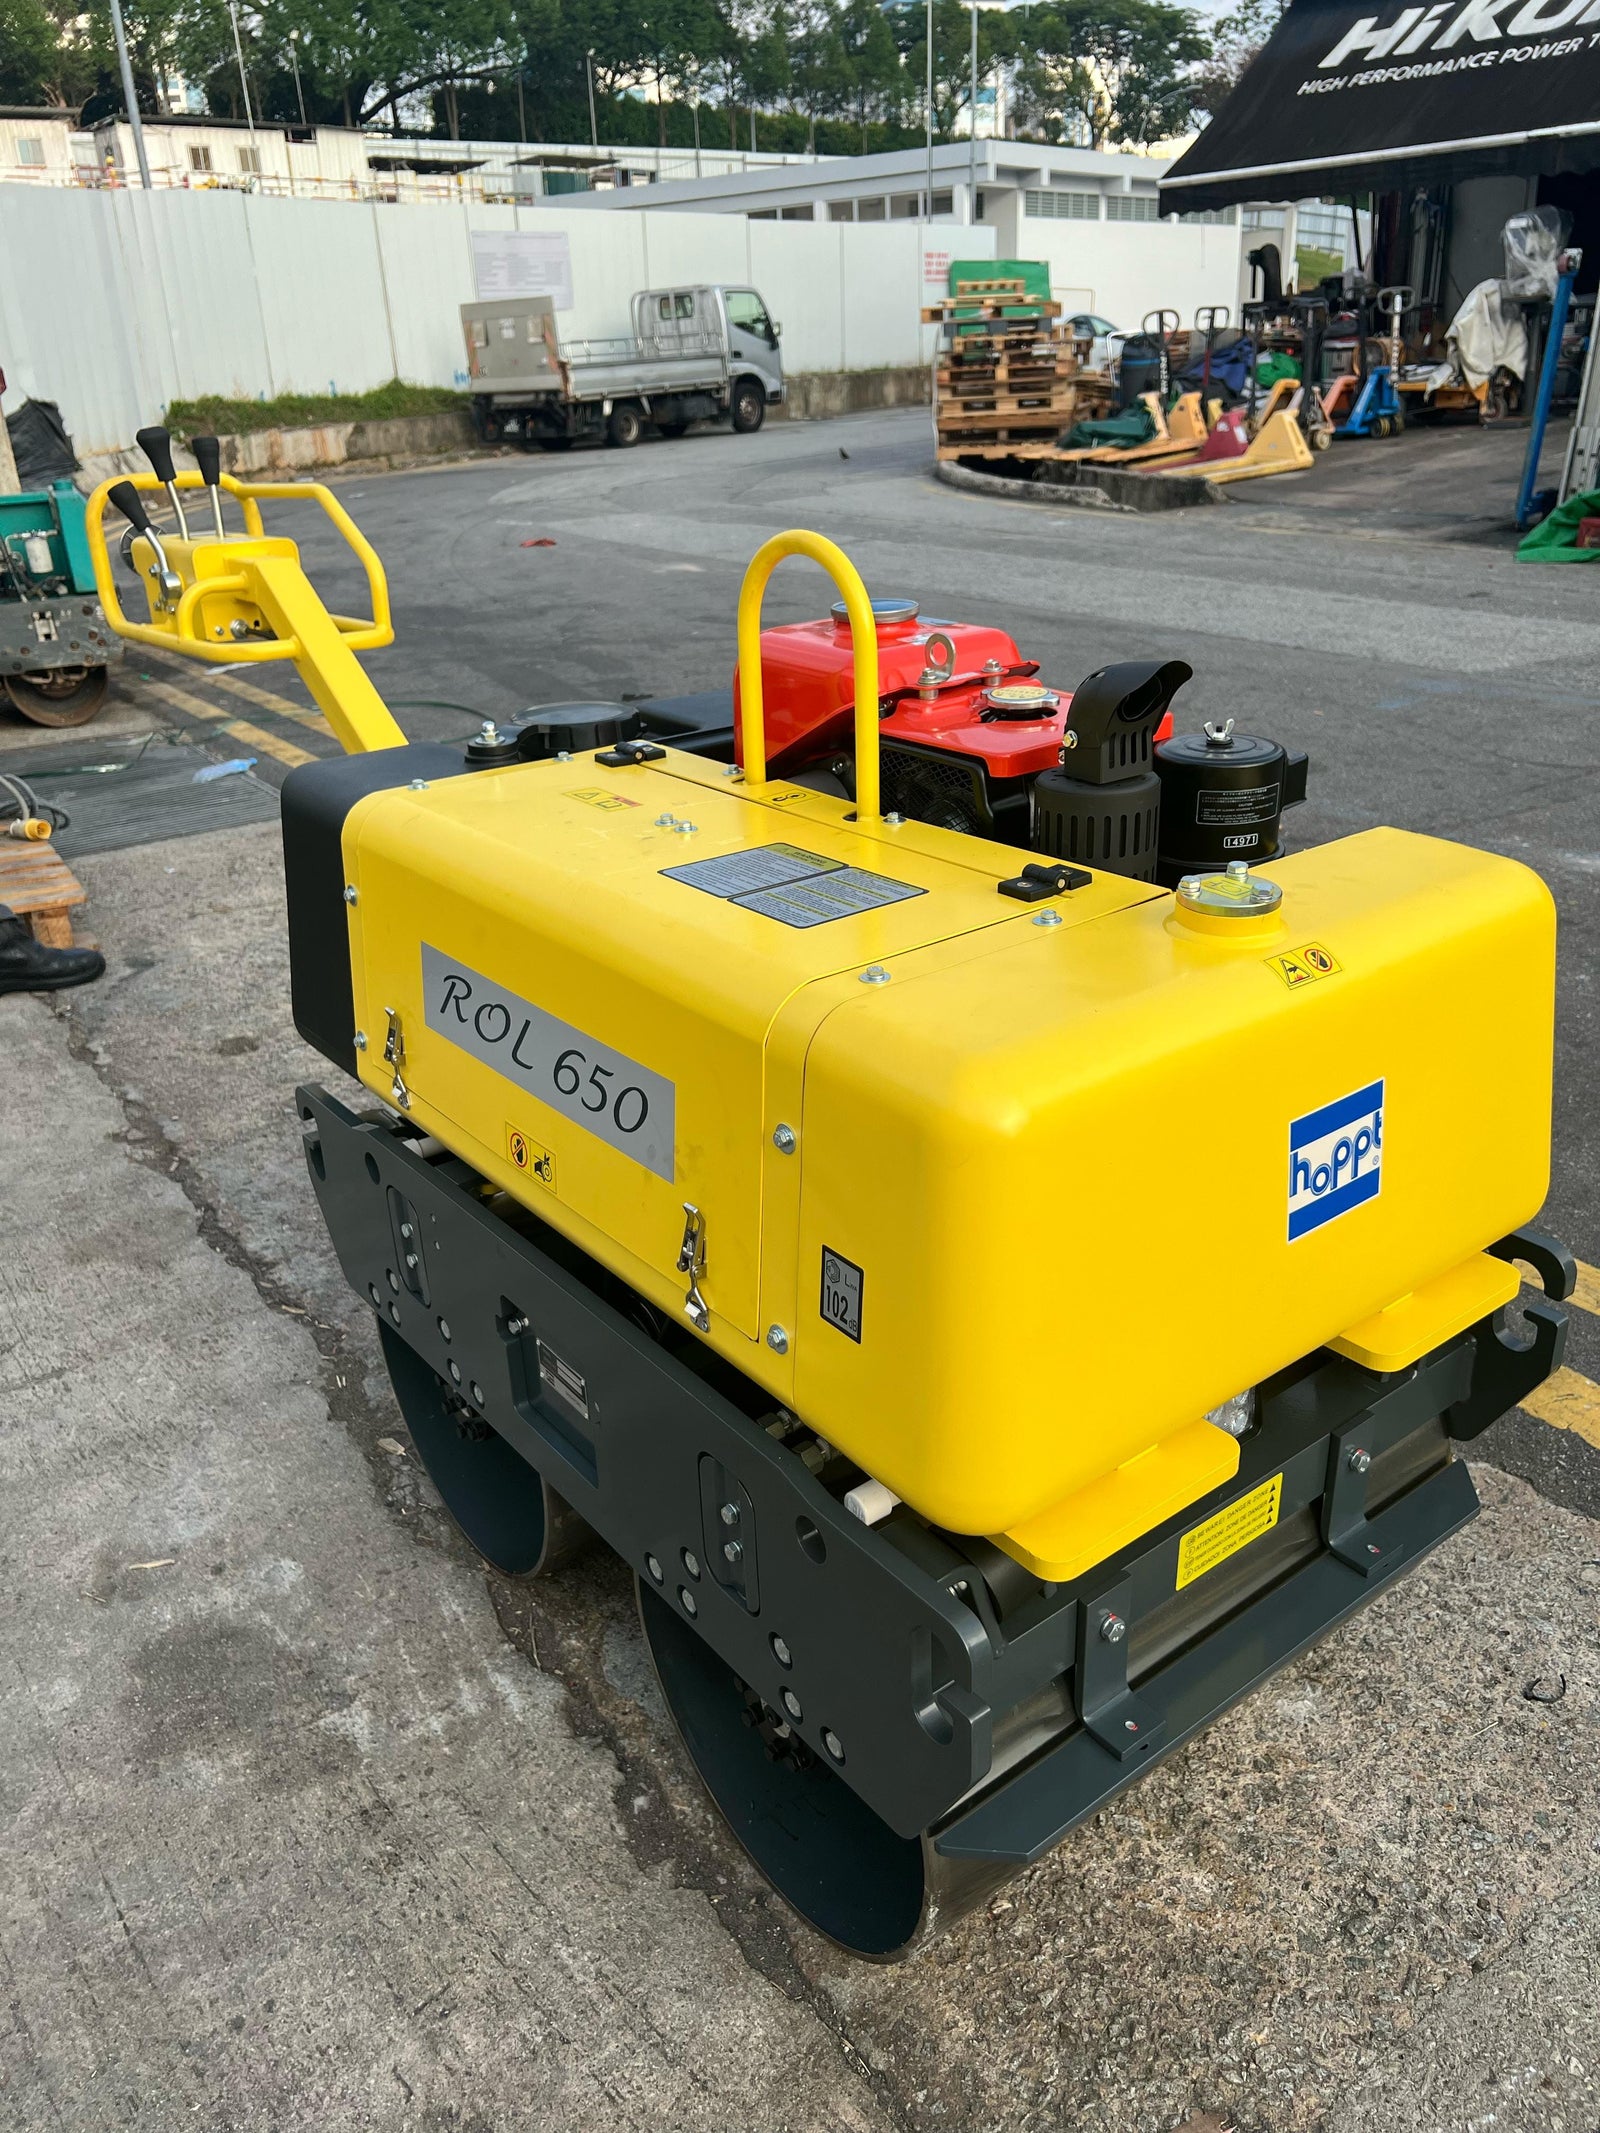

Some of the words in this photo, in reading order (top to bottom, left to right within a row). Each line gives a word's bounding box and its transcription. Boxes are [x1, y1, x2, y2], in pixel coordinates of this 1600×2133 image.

[1297, 75, 1349, 96] HIGH
[1348, 50, 1499, 87] PERFORMANCE
[1498, 37, 1584, 64] POWER
[1588, 32, 1600, 49] T
[1226, 835, 1257, 847] 14971
[440, 974, 534, 1070] ROL
[553, 1049, 649, 1133] 650
[1289, 1110, 1383, 1199] hoppt
[826, 1284, 849, 1326] 102
[848, 1319, 858, 1333] dB
[1227, 1500, 1251, 1519] DANGER
[1253, 1488, 1268, 1502] ZONE
[1247, 1500, 1267, 1517] DANGER
